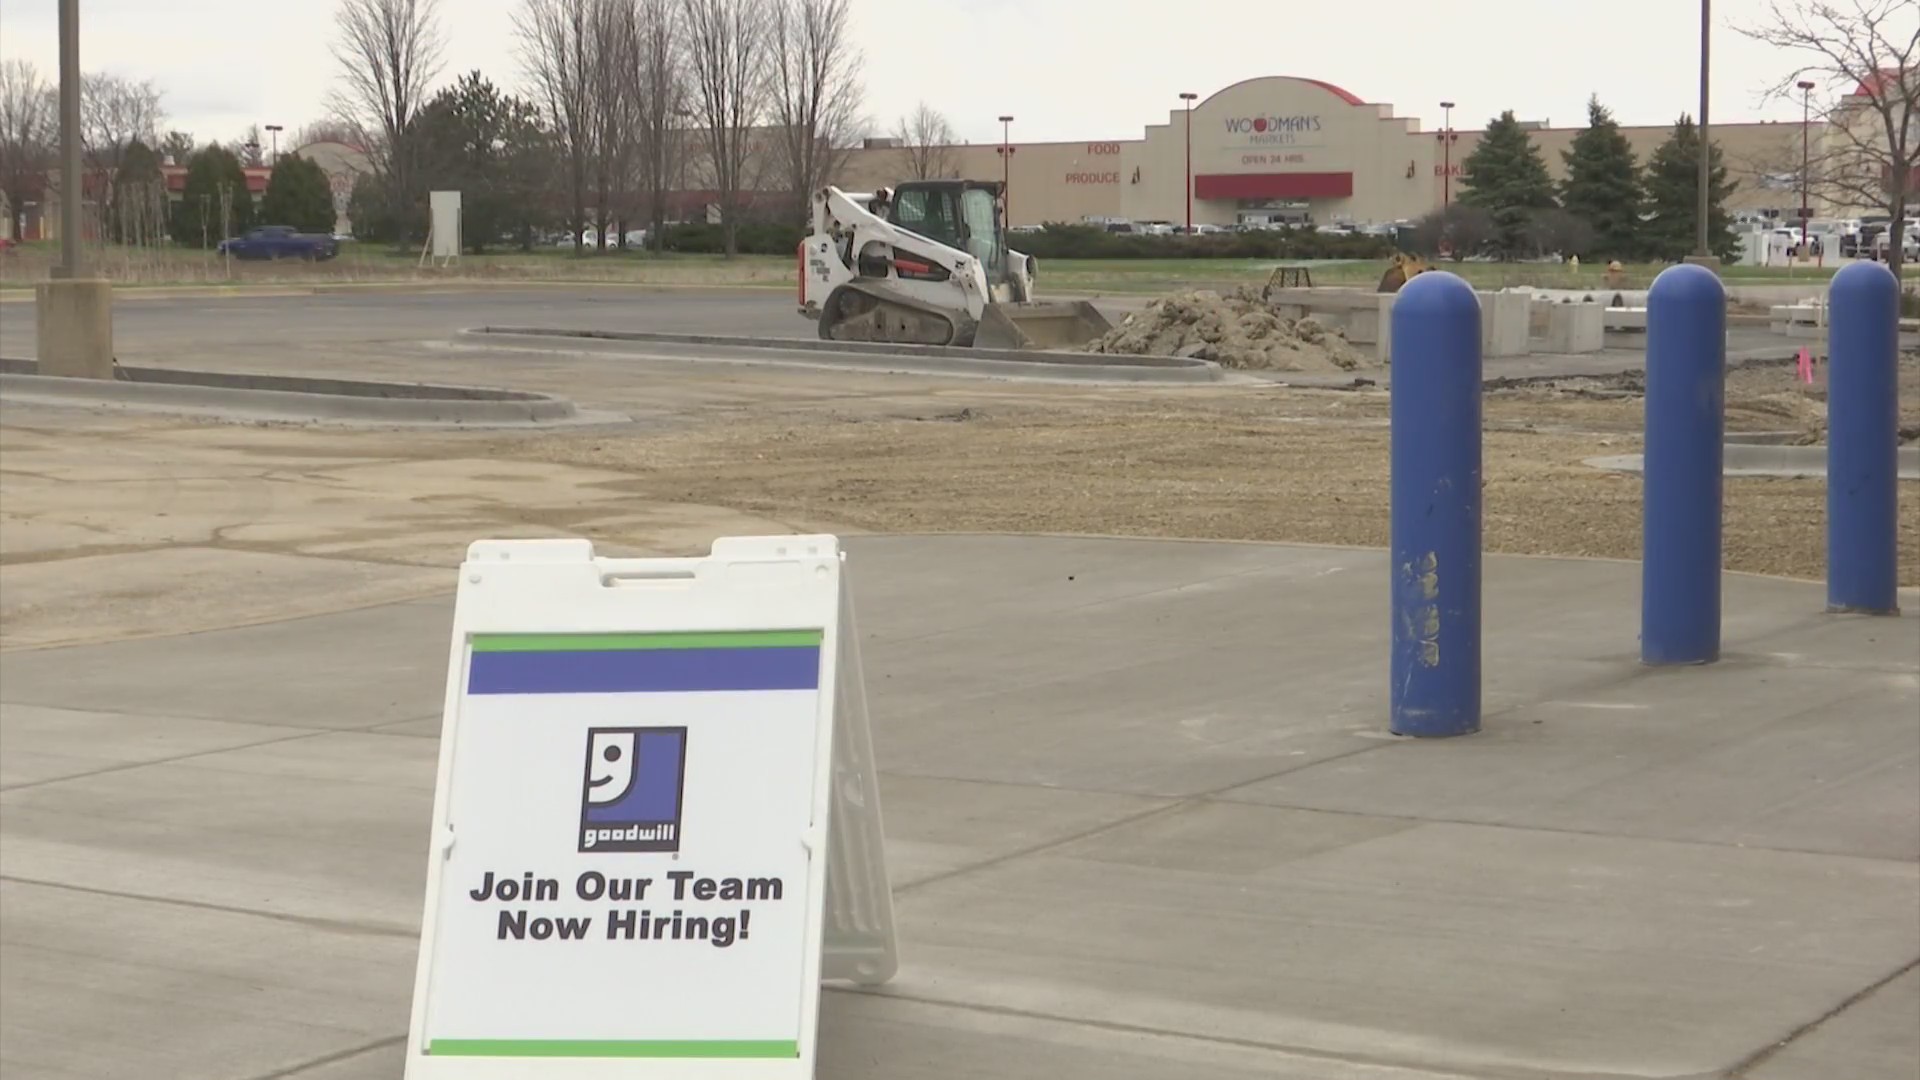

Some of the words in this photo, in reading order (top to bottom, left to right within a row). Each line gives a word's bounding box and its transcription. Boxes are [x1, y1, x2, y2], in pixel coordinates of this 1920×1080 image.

[1249, 134, 1296, 144] MARKETS
[1087, 143, 1120, 155] FOOD
[1241, 155, 1267, 165] OPEN
[1270, 155, 1281, 164] 24
[1065, 172, 1120, 184] PRODUCE
[584, 824, 675, 848] goodwill
[469, 872, 559, 902] Join
[576, 871, 653, 901] Our
[667, 871, 783, 900] Team
[497, 910, 592, 940] Now
[606, 909, 750, 948] Hiring!
